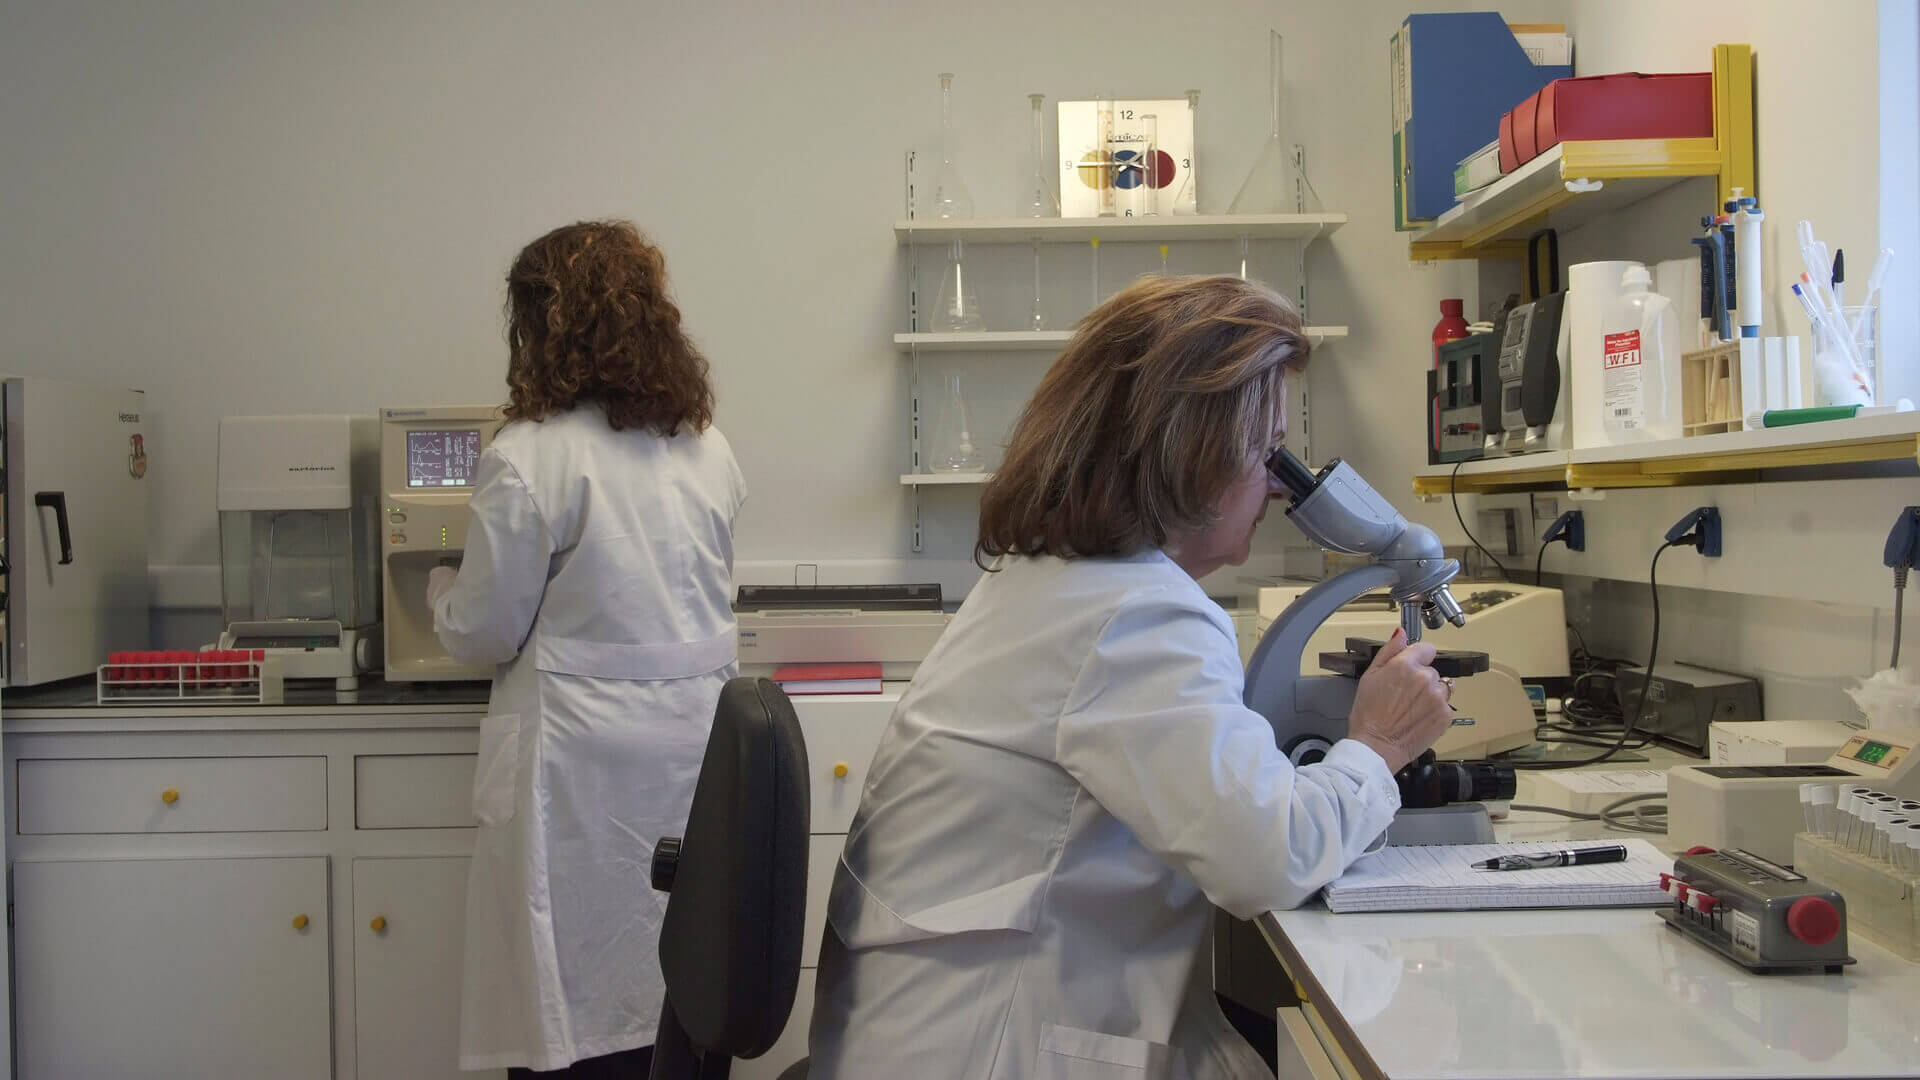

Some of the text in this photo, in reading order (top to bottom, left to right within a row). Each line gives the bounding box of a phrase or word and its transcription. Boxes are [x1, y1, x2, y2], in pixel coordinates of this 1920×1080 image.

[1120, 110, 1133, 120] 12
[1065, 160, 1073, 170] 9
[1182, 159, 1190, 169] 3
[1125, 209, 1133, 217] 6
